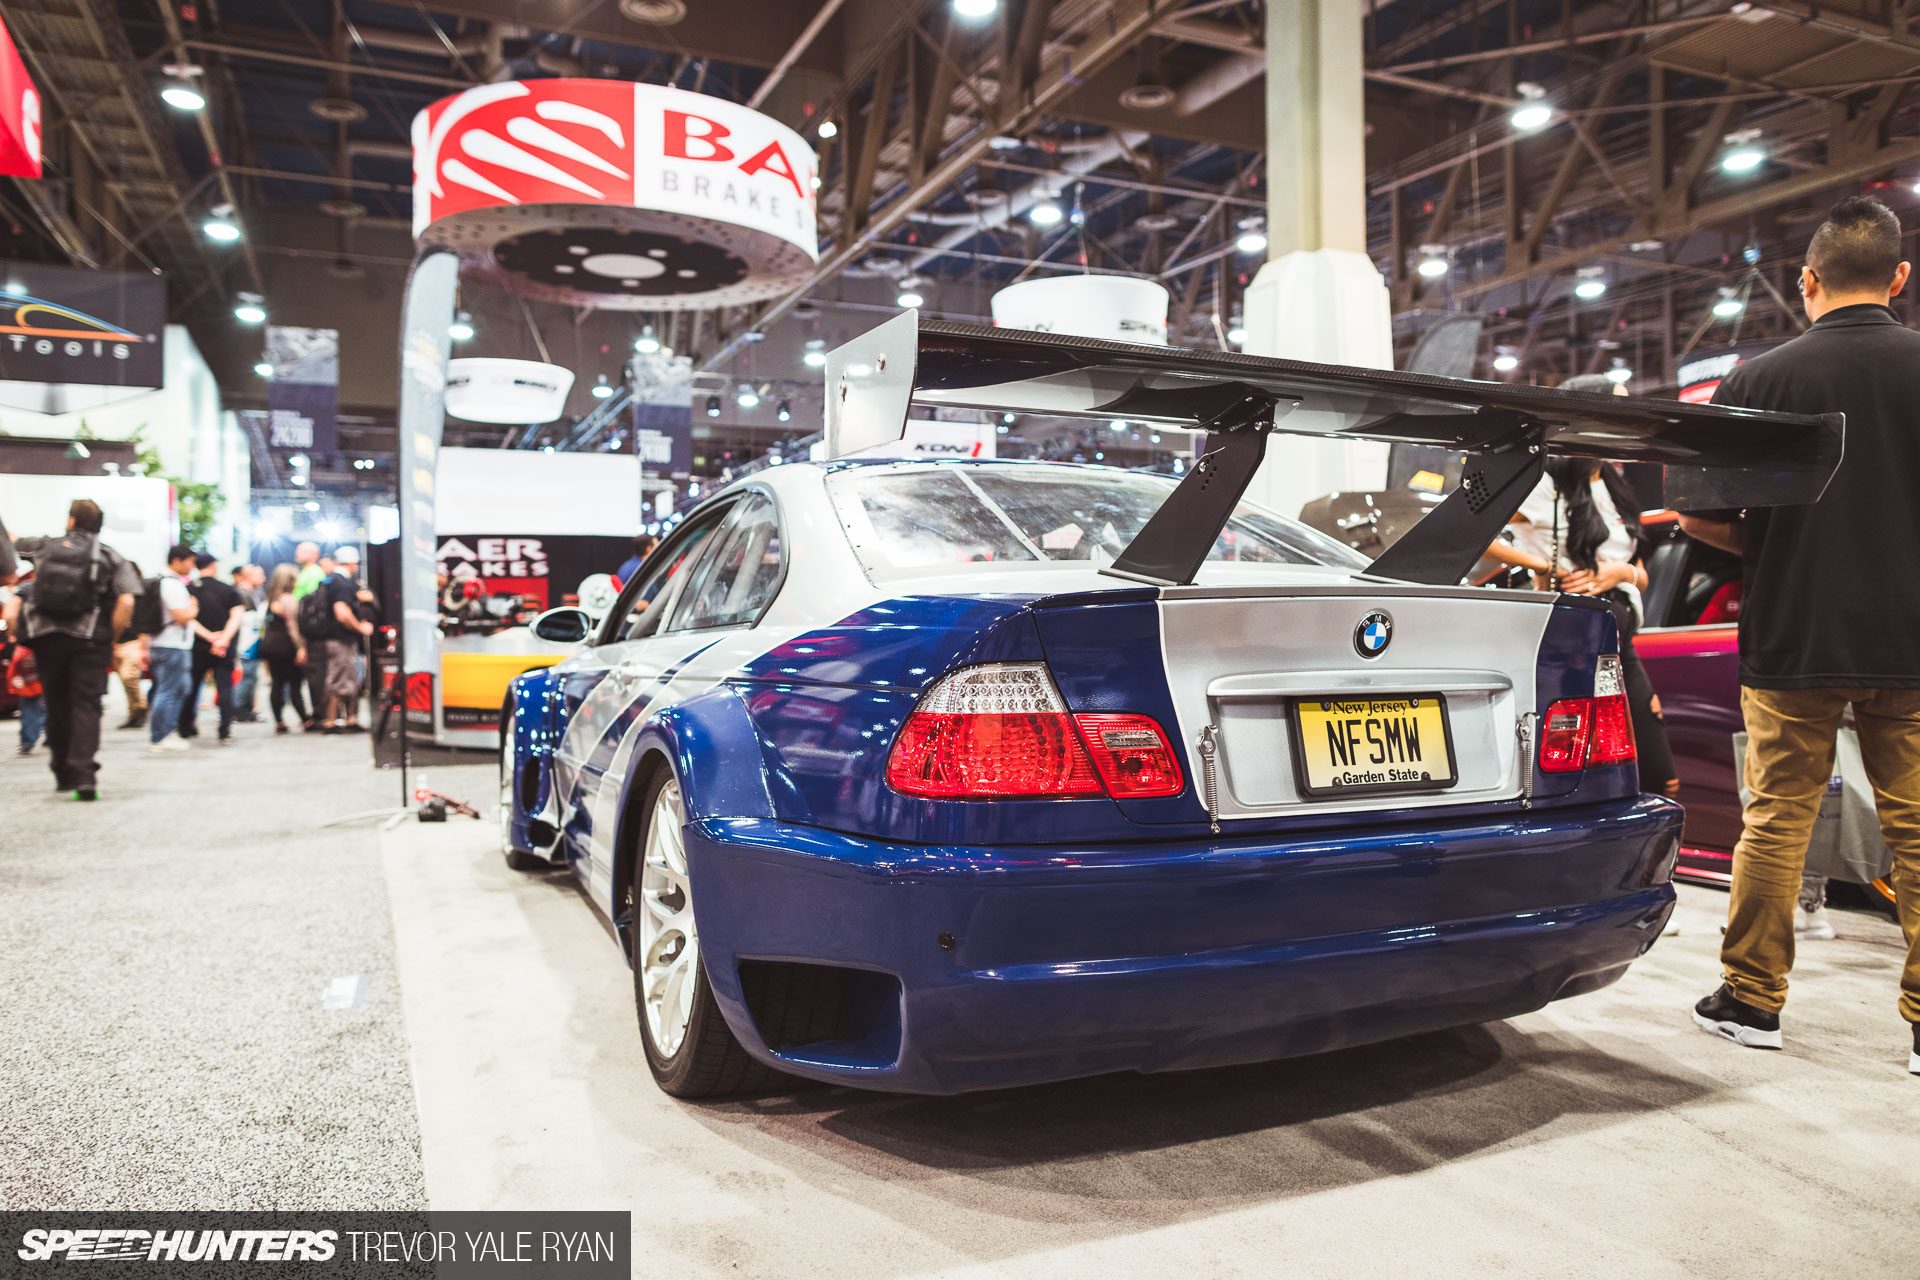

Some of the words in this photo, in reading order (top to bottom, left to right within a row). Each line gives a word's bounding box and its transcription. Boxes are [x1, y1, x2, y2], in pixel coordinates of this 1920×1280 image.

[663, 109, 816, 212] BA
[436, 538, 549, 562] AER
[1362, 614, 1392, 630] BMW
[1333, 701, 1365, 715] New
[1367, 699, 1408, 716] Jersey
[1326, 717, 1422, 767] NFSMW
[1342, 771, 1385, 785] Garden
[1389, 768, 1419, 782] State
